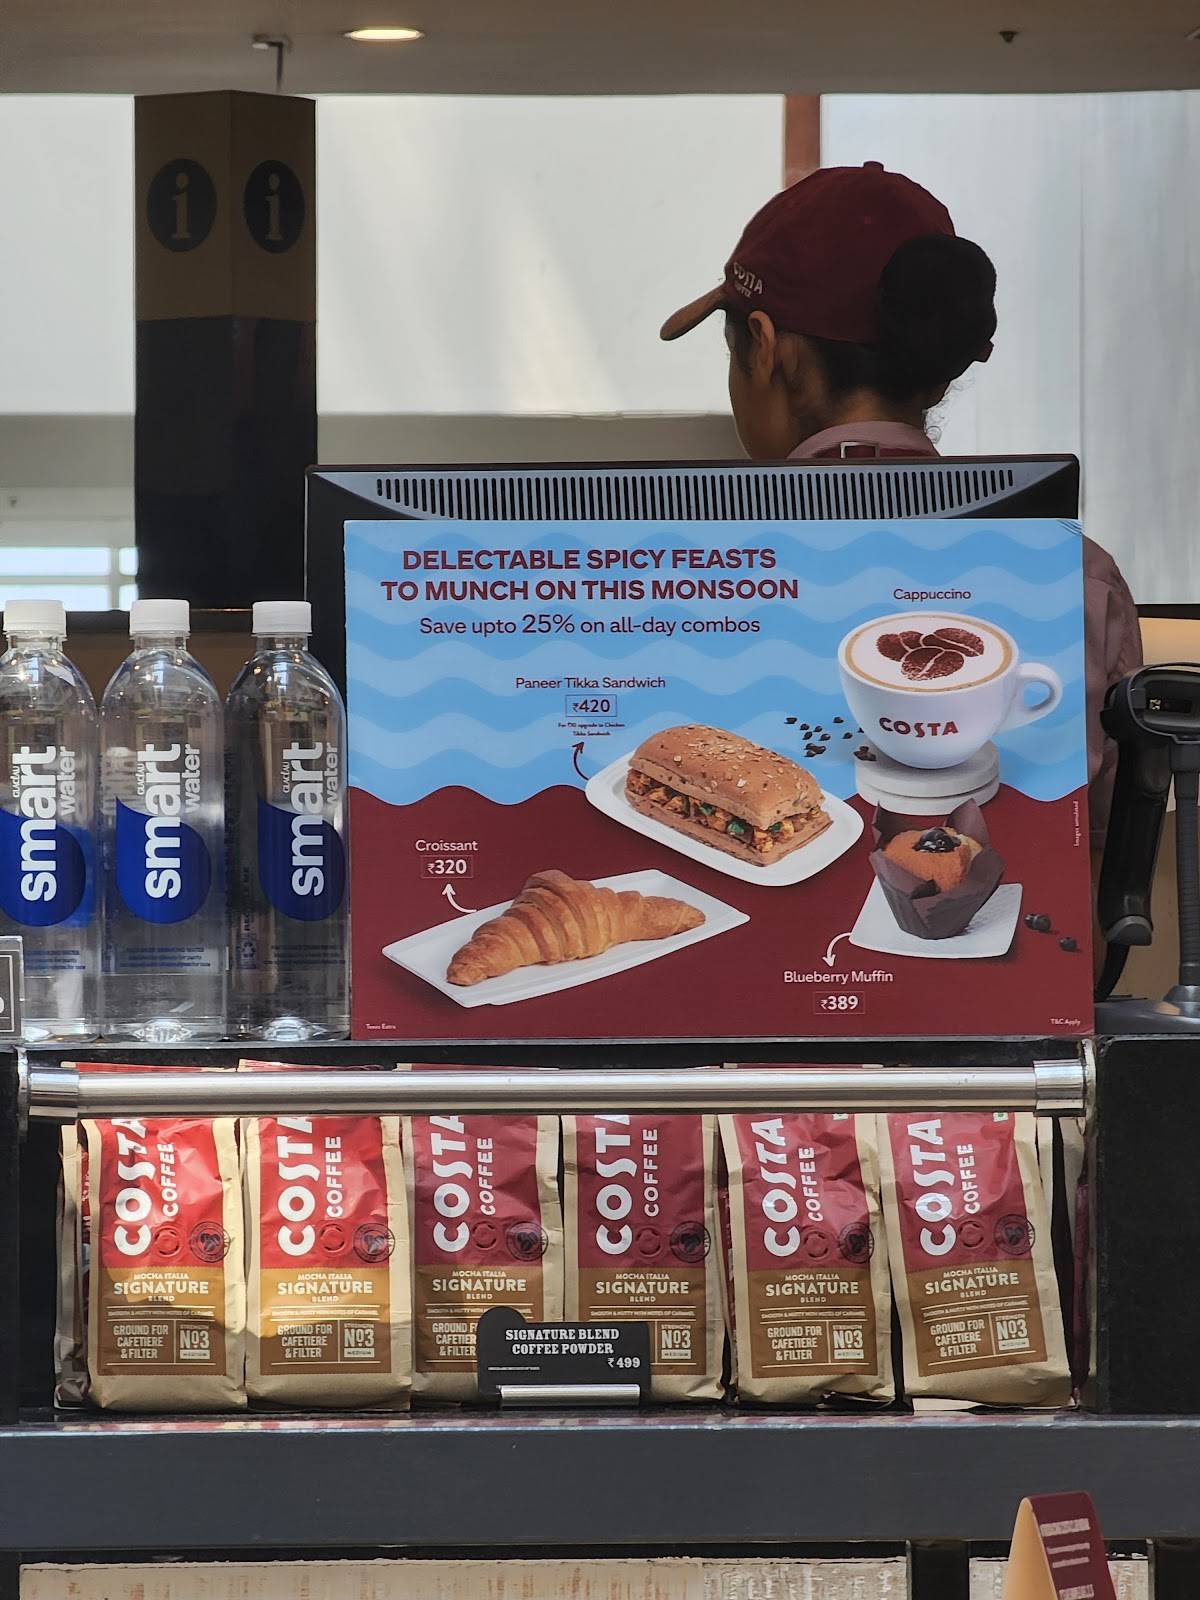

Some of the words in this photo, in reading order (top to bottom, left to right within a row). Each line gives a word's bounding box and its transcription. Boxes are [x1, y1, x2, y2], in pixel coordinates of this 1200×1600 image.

[403, 550, 580, 570] DELECTABLE
[586, 549, 666, 569] SPICY
[672, 548, 776, 569] FEASTS
[380, 581, 419, 600] TO
[425, 580, 529, 600] MUNCH
[535, 580, 576, 600] ON
[581, 580, 645, 600] THIS
[652, 579, 799, 599] MONSOON
[893, 588, 972, 602] Cappuccino
[419, 617, 467, 634] Save
[472, 618, 517, 638] upto
[521, 614, 576, 633] 25%
[580, 620, 605, 633] on
[610, 616, 676, 637] all-day
[681, 616, 761, 633] combos
[515, 677, 562, 689] Paneer
[563, 677, 600, 689] Tikka
[602, 676, 666, 689] Sandwich
[571, 699, 611, 713] ₹420
[879, 717, 959, 738] COSTA
[57, 746, 76, 816] water
[182, 743, 200, 813] water
[12, 746, 57, 902] smart
[137, 743, 181, 899] smart
[283, 742, 325, 896] smart
[415, 839, 479, 852] Croissant
[427, 859, 467, 875] ₹320
[783, 970, 849, 985] Blueberry
[851, 970, 894, 983] Muffin
[820, 995, 859, 1010] ₹389
[157, 1142, 179, 1217] COFFEE
[325, 1136, 344, 1218] COFFEE
[477, 1137, 497, 1216] COFFEE
[642, 1128, 660, 1217] COFFEE
[956, 1143, 980, 1214] COFFEE
[111, 1118, 156, 1256] COSTA
[277, 1116, 320, 1256] COSTA
[429, 1115, 473, 1252] COSTA
[751, 1117, 801, 1257] COSTA
[798, 1147, 824, 1222] COFFEE
[907, 1119, 957, 1256] COSTA
[298, 1273, 325, 1281] MOCHA
[482, 1270, 507, 1278] ITALIA
[943, 1269, 973, 1278] MOCHA
[974, 1266, 998, 1275] ITALIA
[113, 1281, 209, 1295] SIGNATURE
[277, 1281, 373, 1295] SIGNATURE
[432, 1278, 527, 1292] SIGNATURE
[595, 1281, 690, 1294] SIGNATURE
[765, 1281, 859, 1297] SIGNATURE
[924, 1272, 1020, 1295] SIGNATURE
[311, 1295, 339, 1303] BLEND
[960, 1290, 987, 1298] BLEND
[113, 1325, 149, 1335] GROUND
[151, 1324, 168, 1335] FOR
[277, 1324, 313, 1335] GROUND
[315, 1324, 333, 1335] FOR
[432, 1322, 467, 1333] GROUND
[505, 1328, 576, 1341] SIGNATURE
[578, 1328, 620, 1340] BLEND
[767, 1327, 803, 1338] GROUND
[805, 1325, 822, 1336] FOR
[930, 1321, 965, 1336] GROUND
[967, 1319, 985, 1331] FOR
[117, 1336, 164, 1347] CAFETIERE
[281, 1336, 328, 1347] CAFETIERE
[435, 1334, 477, 1345] CAFETIER
[771, 1337, 818, 1349] CAFETIERE
[935, 1331, 981, 1346] CAFETIERE
[120, 1348, 128, 1359] &
[129, 1348, 158, 1359] FILTER
[285, 1348, 292, 1358] &
[293, 1347, 322, 1358] FILTER
[439, 1346, 447, 1356] &
[447, 1345, 477, 1356] FILTER
[512, 1343, 559, 1355] COFFEE
[561, 1343, 614, 1355] POWDER
[776, 1350, 783, 1360] &
[784, 1349, 813, 1360] FILTER
[940, 1346, 947, 1357] &
[947, 1343, 977, 1357] FILTER
